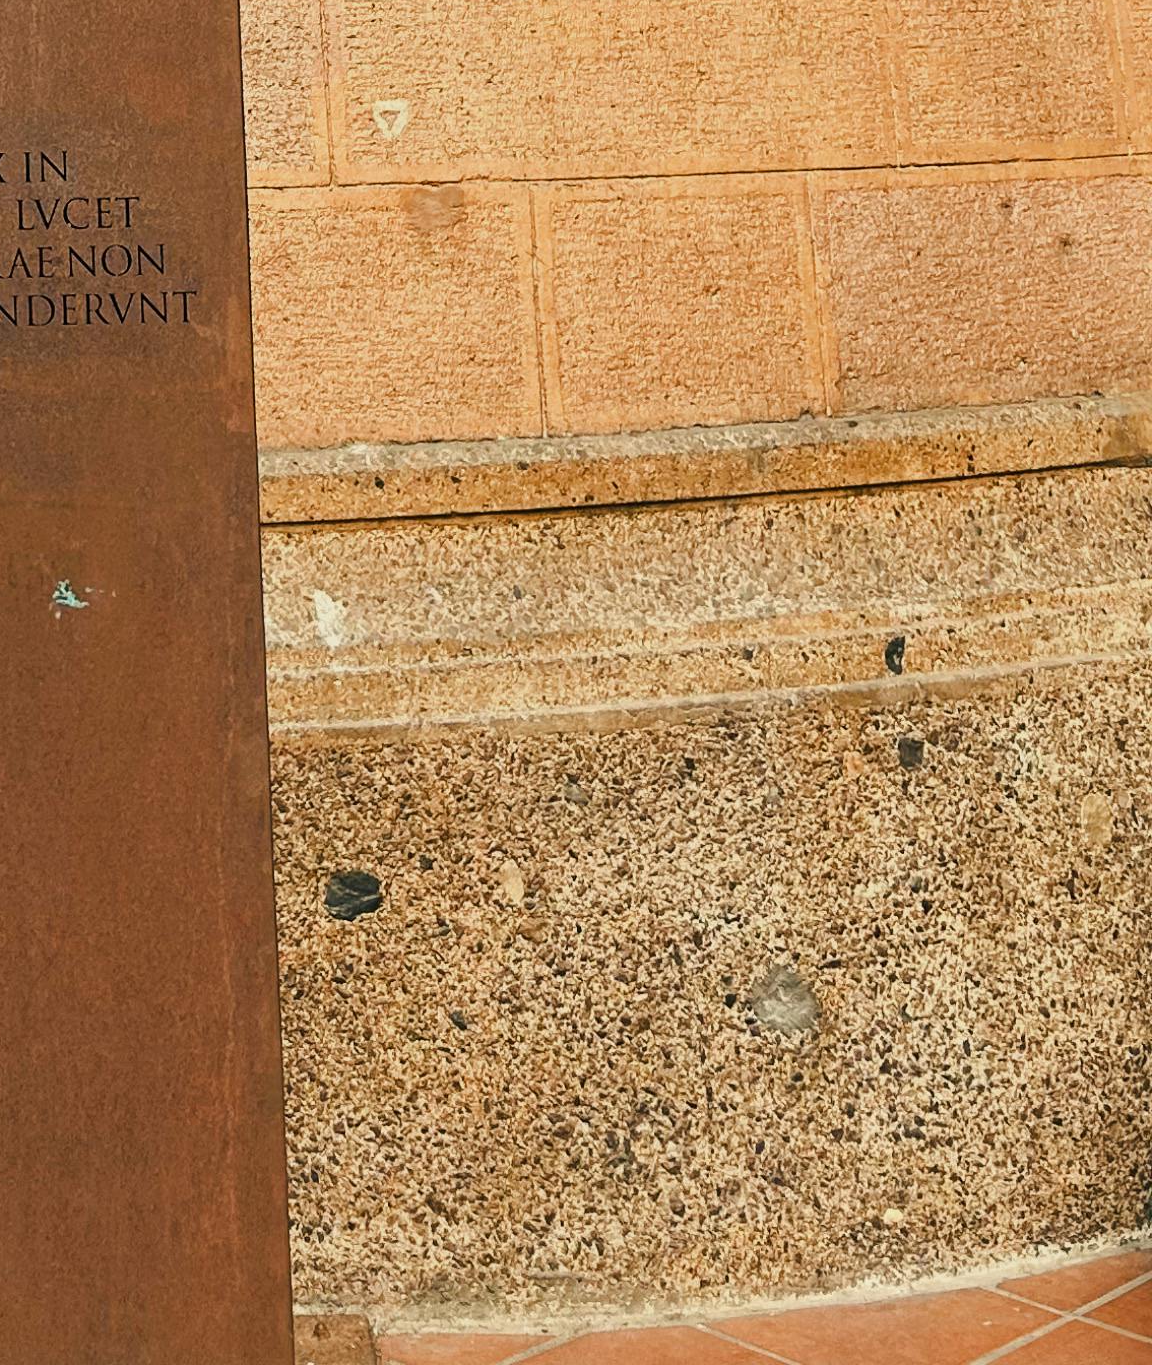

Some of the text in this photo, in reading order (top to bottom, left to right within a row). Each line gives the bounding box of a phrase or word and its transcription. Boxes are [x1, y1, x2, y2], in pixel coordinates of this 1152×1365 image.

[24, 150, 69, 183] IN
[16, 196, 140, 231] LVCET
[67, 243, 165, 278] NON
